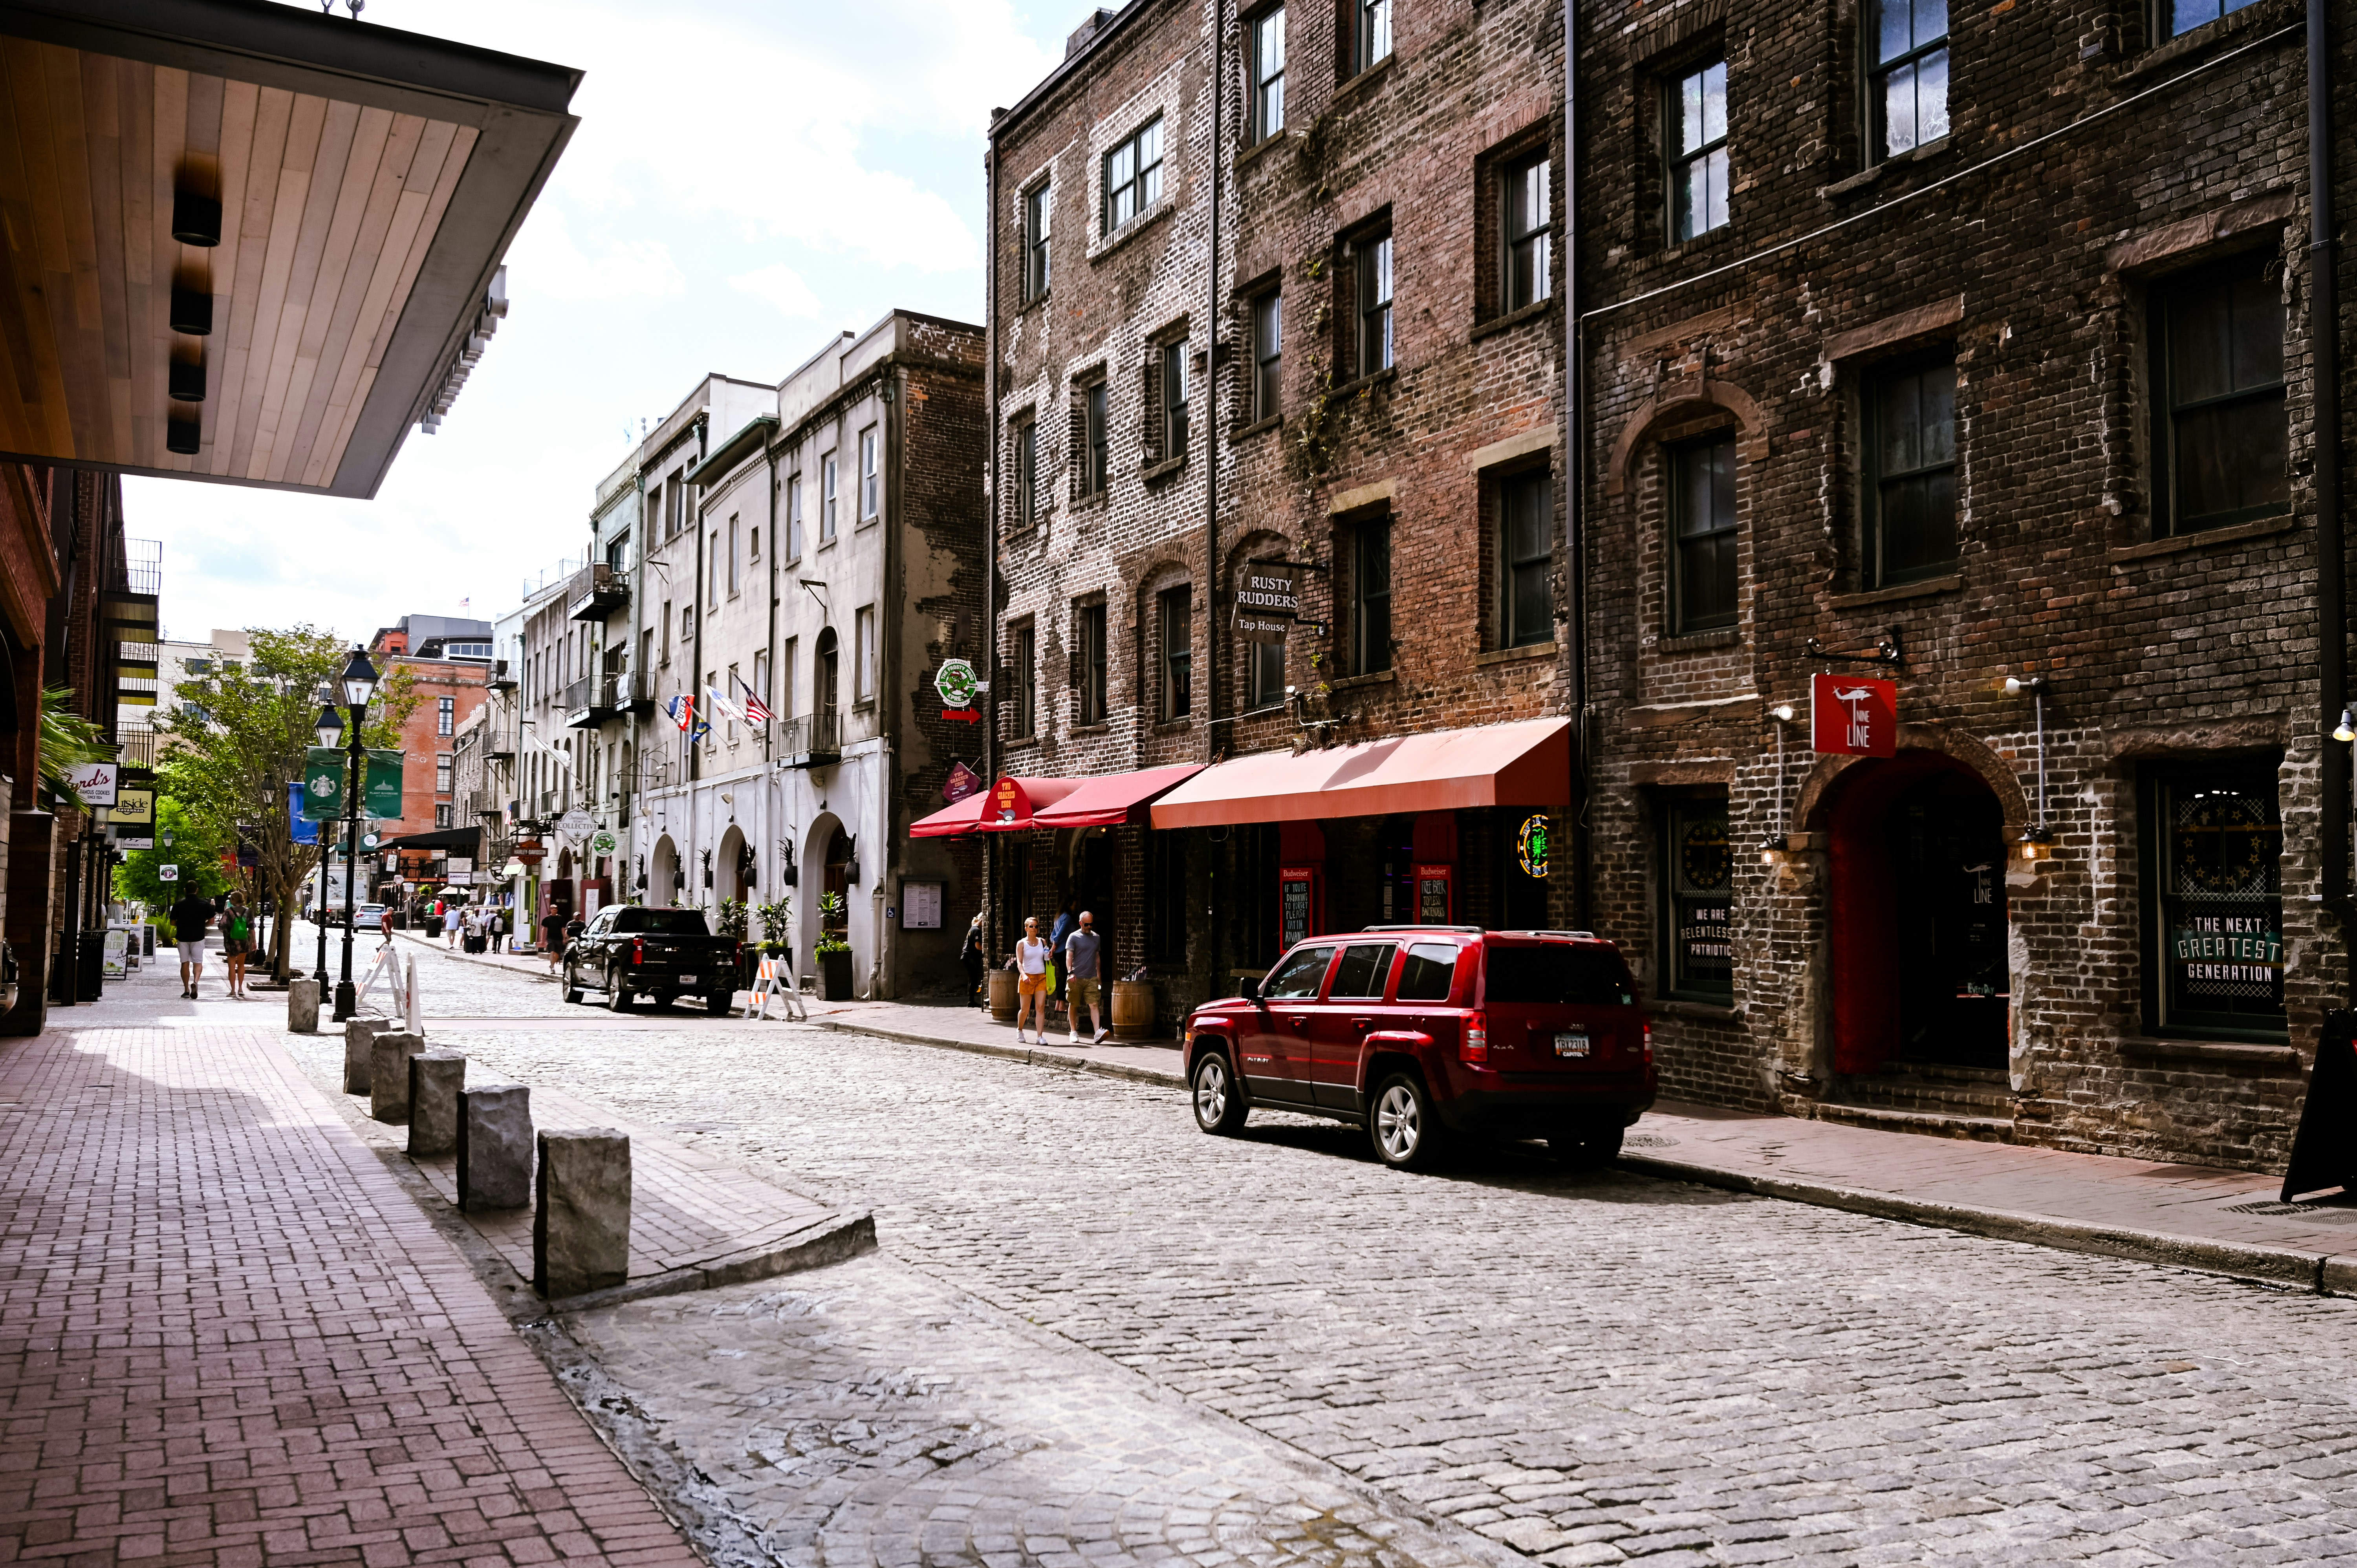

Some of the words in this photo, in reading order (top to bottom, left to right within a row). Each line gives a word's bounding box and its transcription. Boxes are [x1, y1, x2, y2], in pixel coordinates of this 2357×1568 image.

[1251, 576, 1292, 591] RUSTY
[1238, 591, 1298, 608] RUDDERS
[1238, 619, 1255, 631] Tap
[1258, 620, 1285, 632] House
[965, 669, 974, 681] FROG
[947, 693, 969, 701] XPRE
[1856, 710, 1870, 722] NINE
[1847, 725, 1870, 748] LINE
[950, 774, 969, 784] CRACKED
[1002, 782, 1011, 790] TWO
[998, 791, 1015, 800] CRACKED
[118, 798, 148, 810] utside
[1293, 883, 1306, 892] YOU'RE
[1421, 880, 1432, 894] FREE
[1432, 880, 1446, 895] BEER
[1286, 893, 1308, 902] DRINKING
[1423, 896, 1441, 906] TOPLESS
[1974, 888, 1992, 903] LINE
[1286, 909, 1306, 920] PLEASE
[1696, 909, 1708, 920] WE
[1711, 909, 1725, 920] ARE
[1287, 920, 1296, 929] PAY
[1297, 920, 1302, 929] IN
[2195, 917, 2220, 932] THE
[2226, 918, 2262, 933] NEXT
[105, 941, 124, 950] OLERS
[1691, 944, 1731, 956] PATRIOTIC
[2178, 937, 2280, 961] GREATEST
[2188, 964, 2272, 981] GENERATION
